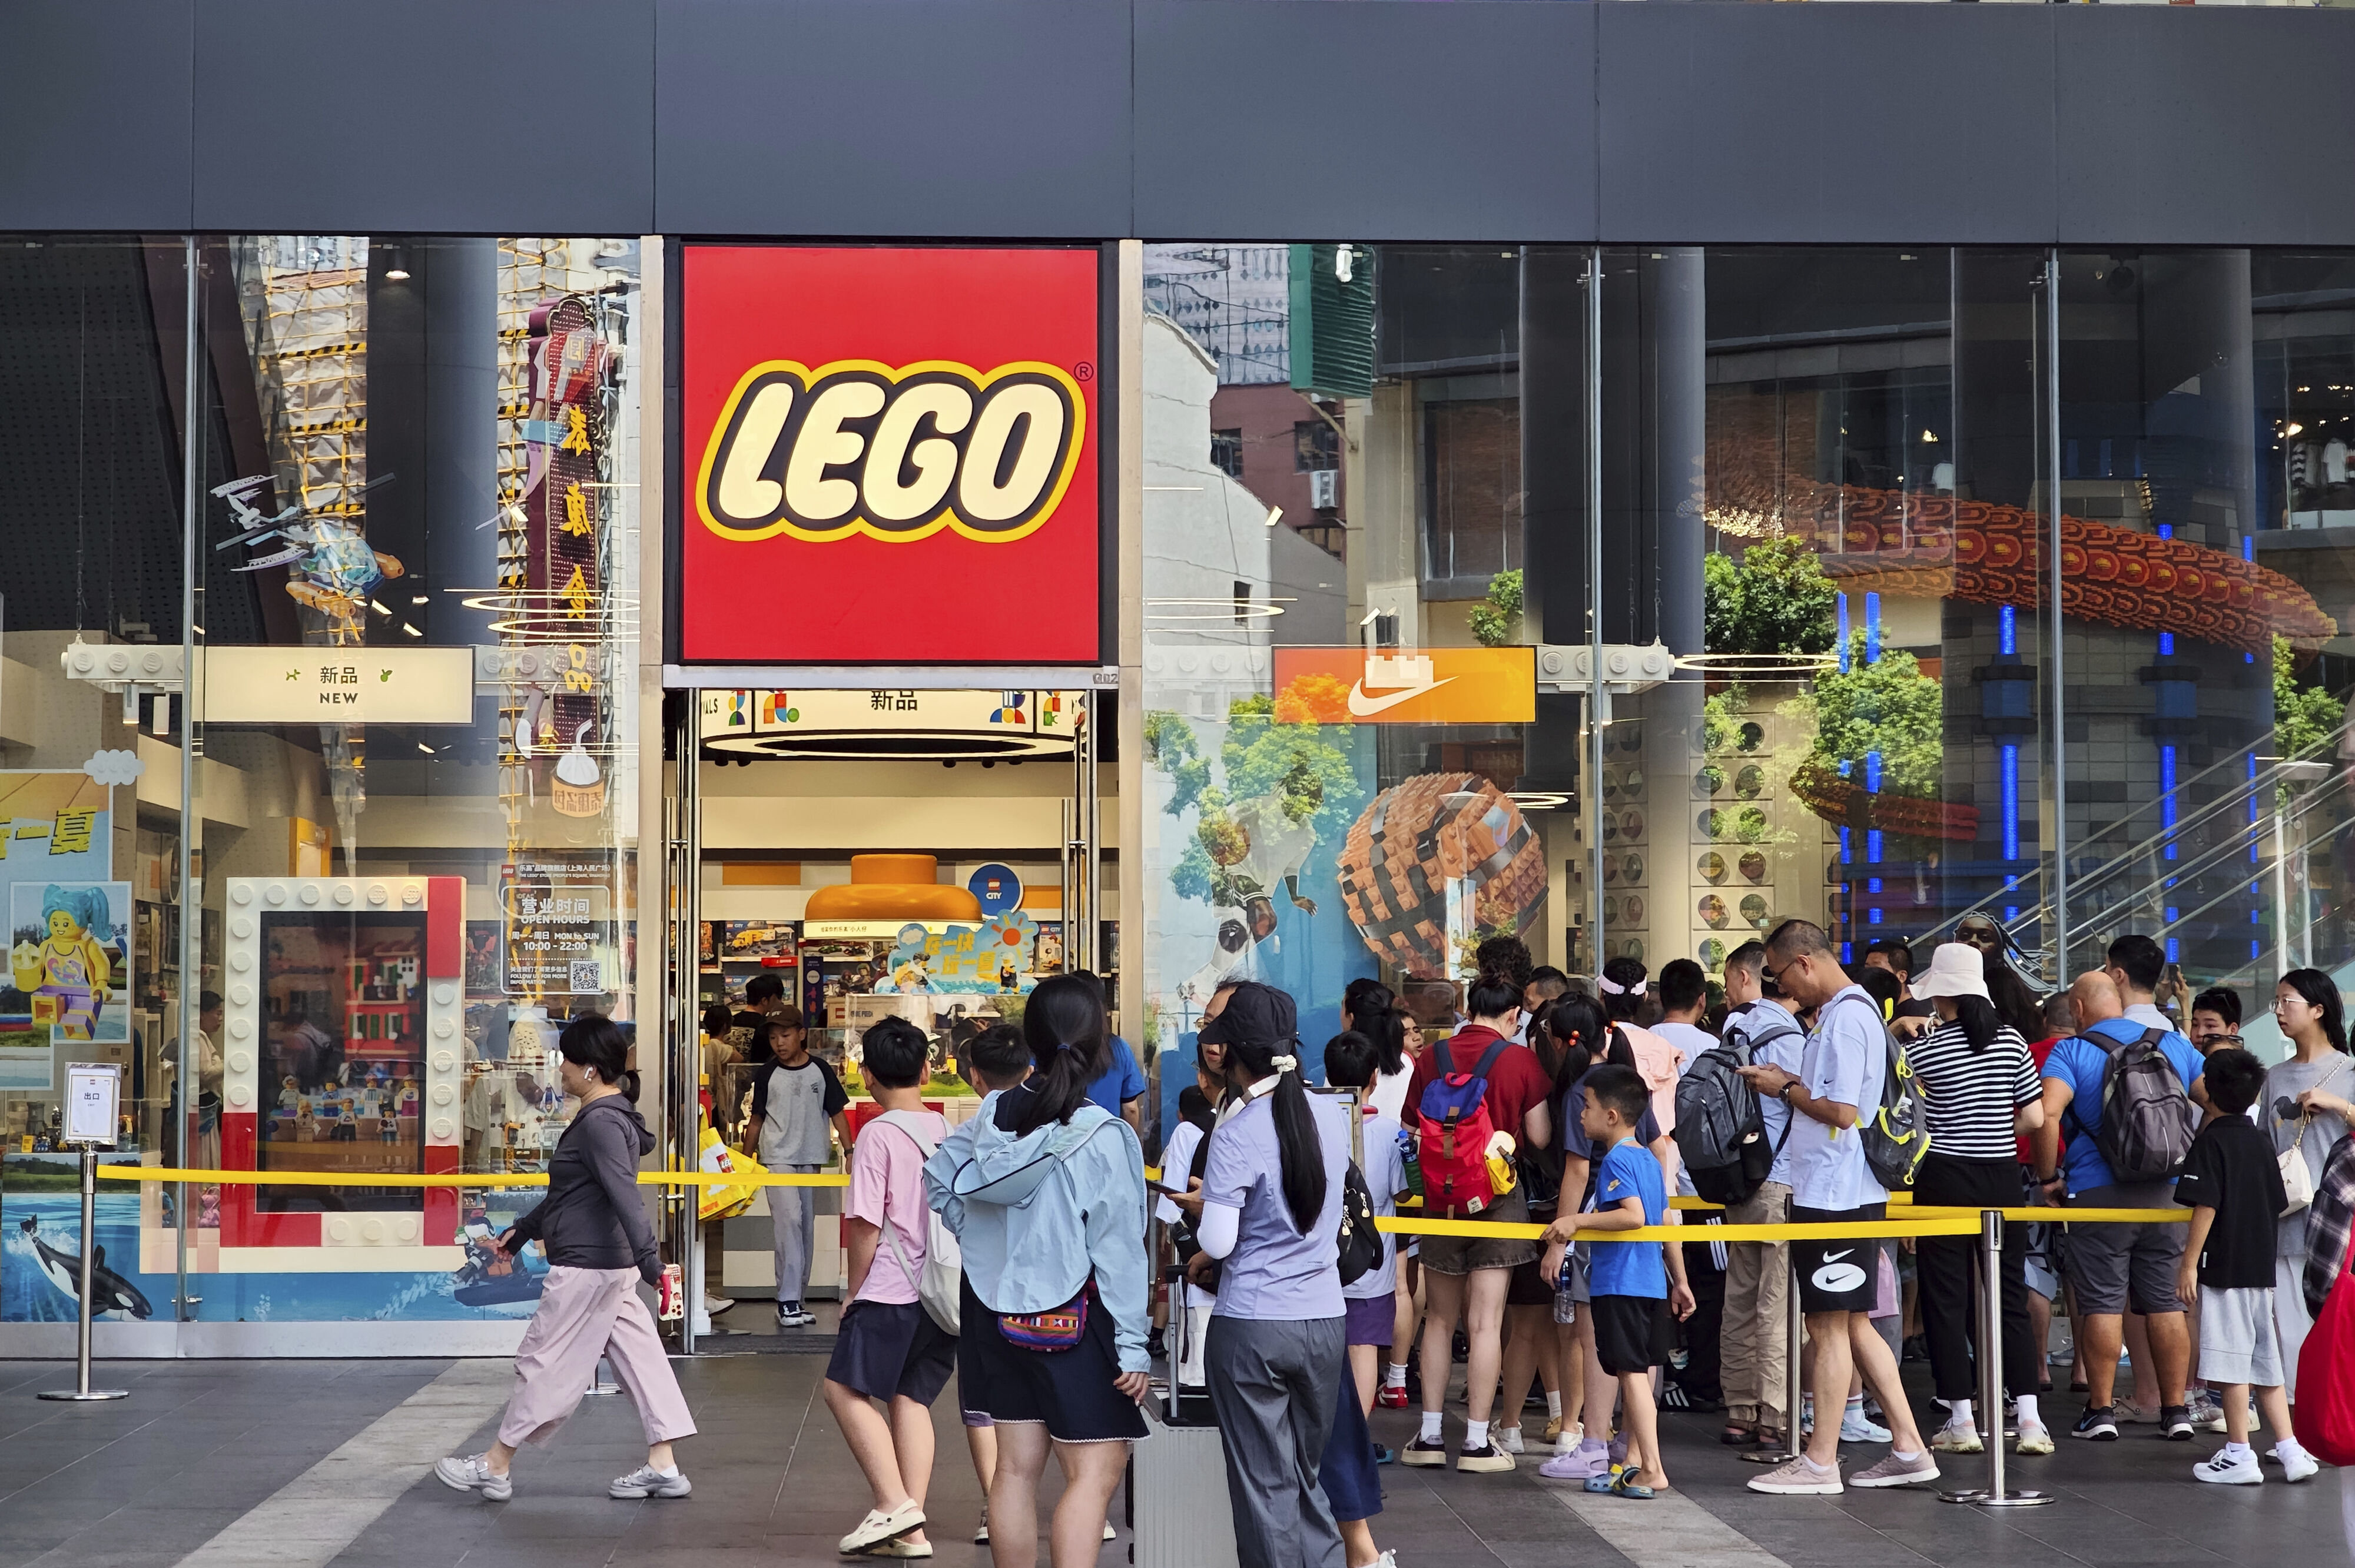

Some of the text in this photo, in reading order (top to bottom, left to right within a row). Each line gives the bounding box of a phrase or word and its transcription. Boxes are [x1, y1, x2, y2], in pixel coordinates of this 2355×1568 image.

[708, 371, 1074, 532] LEGO
[320, 666, 357, 685] 新品
[320, 693, 358, 704] NEW
[871, 690, 918, 711] 新品
[522, 898, 589, 915] 营业时间
[521, 915, 590, 924] OPEN HOURS
[523, 942, 551, 951] 10:00
[560, 942, 588, 951] 22:00
